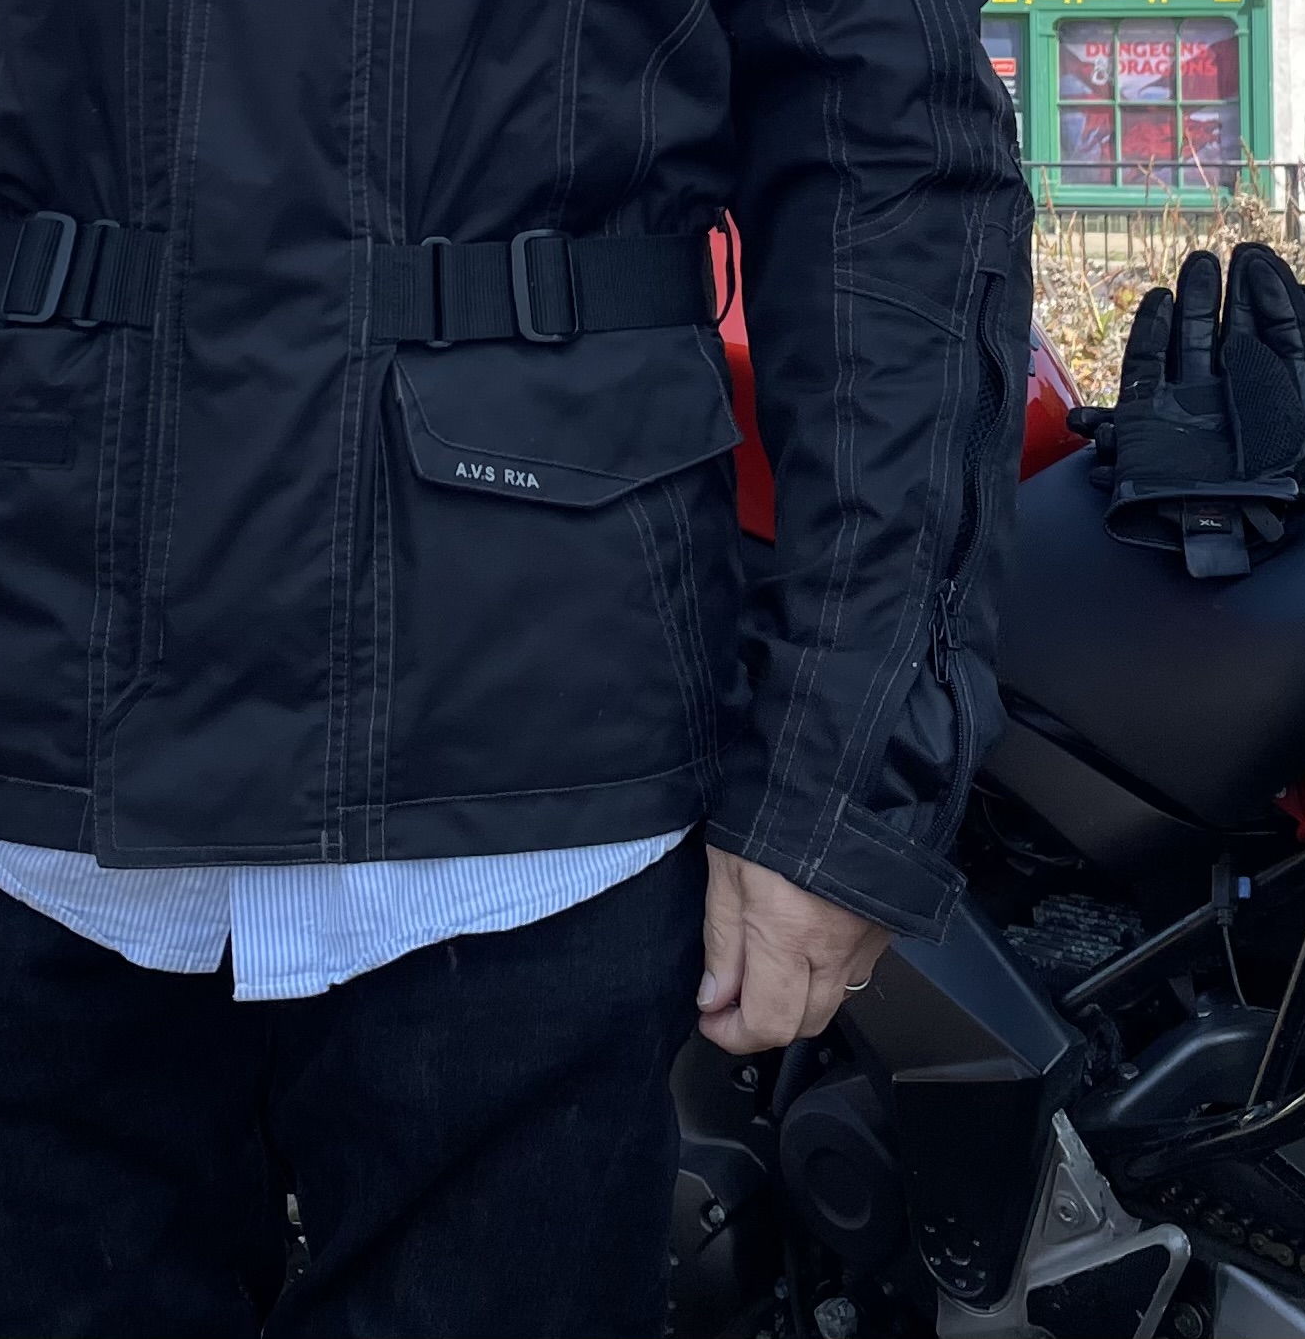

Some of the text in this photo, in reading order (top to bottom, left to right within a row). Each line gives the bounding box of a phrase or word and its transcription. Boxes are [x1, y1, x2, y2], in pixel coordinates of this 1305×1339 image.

[455, 462, 540, 489] A.V.S RXA
[1199, 519, 1222, 527] XL
